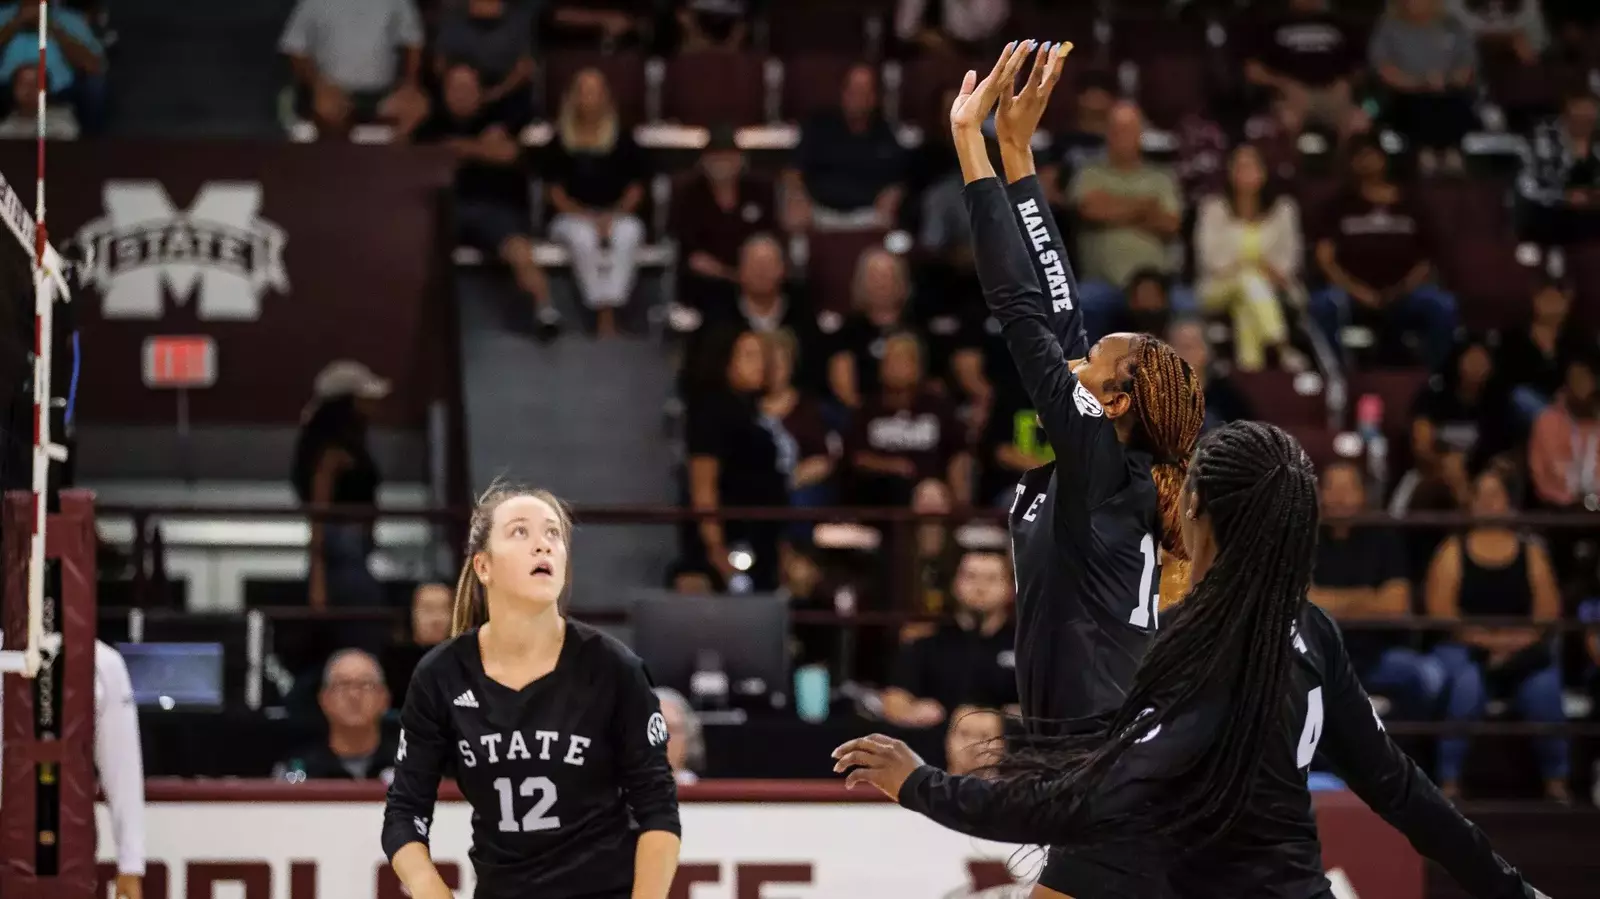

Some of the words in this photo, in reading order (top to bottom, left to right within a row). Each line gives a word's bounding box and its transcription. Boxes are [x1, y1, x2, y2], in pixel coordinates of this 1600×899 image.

[1017, 198, 1051, 252] HAIL
[1039, 249, 1073, 313] STATE
[458, 730, 591, 767] STATE
[493, 776, 561, 832] 12
